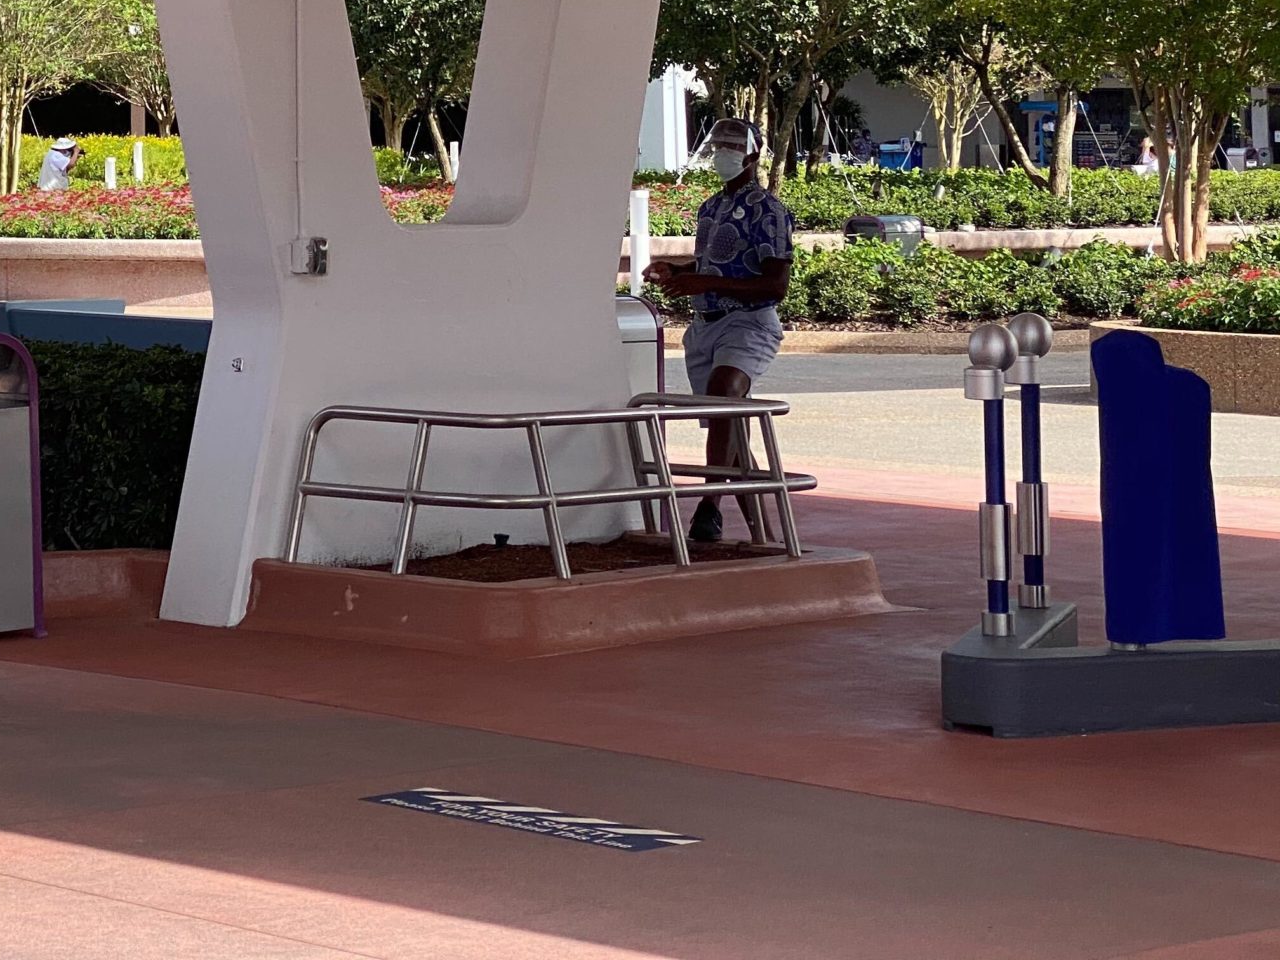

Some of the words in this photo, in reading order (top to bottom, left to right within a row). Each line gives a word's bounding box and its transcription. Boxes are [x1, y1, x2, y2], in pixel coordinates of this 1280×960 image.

[439, 809, 490, 820] WAIT
[476, 809, 536, 822] YOUR
[535, 821, 624, 838] SAFETY
